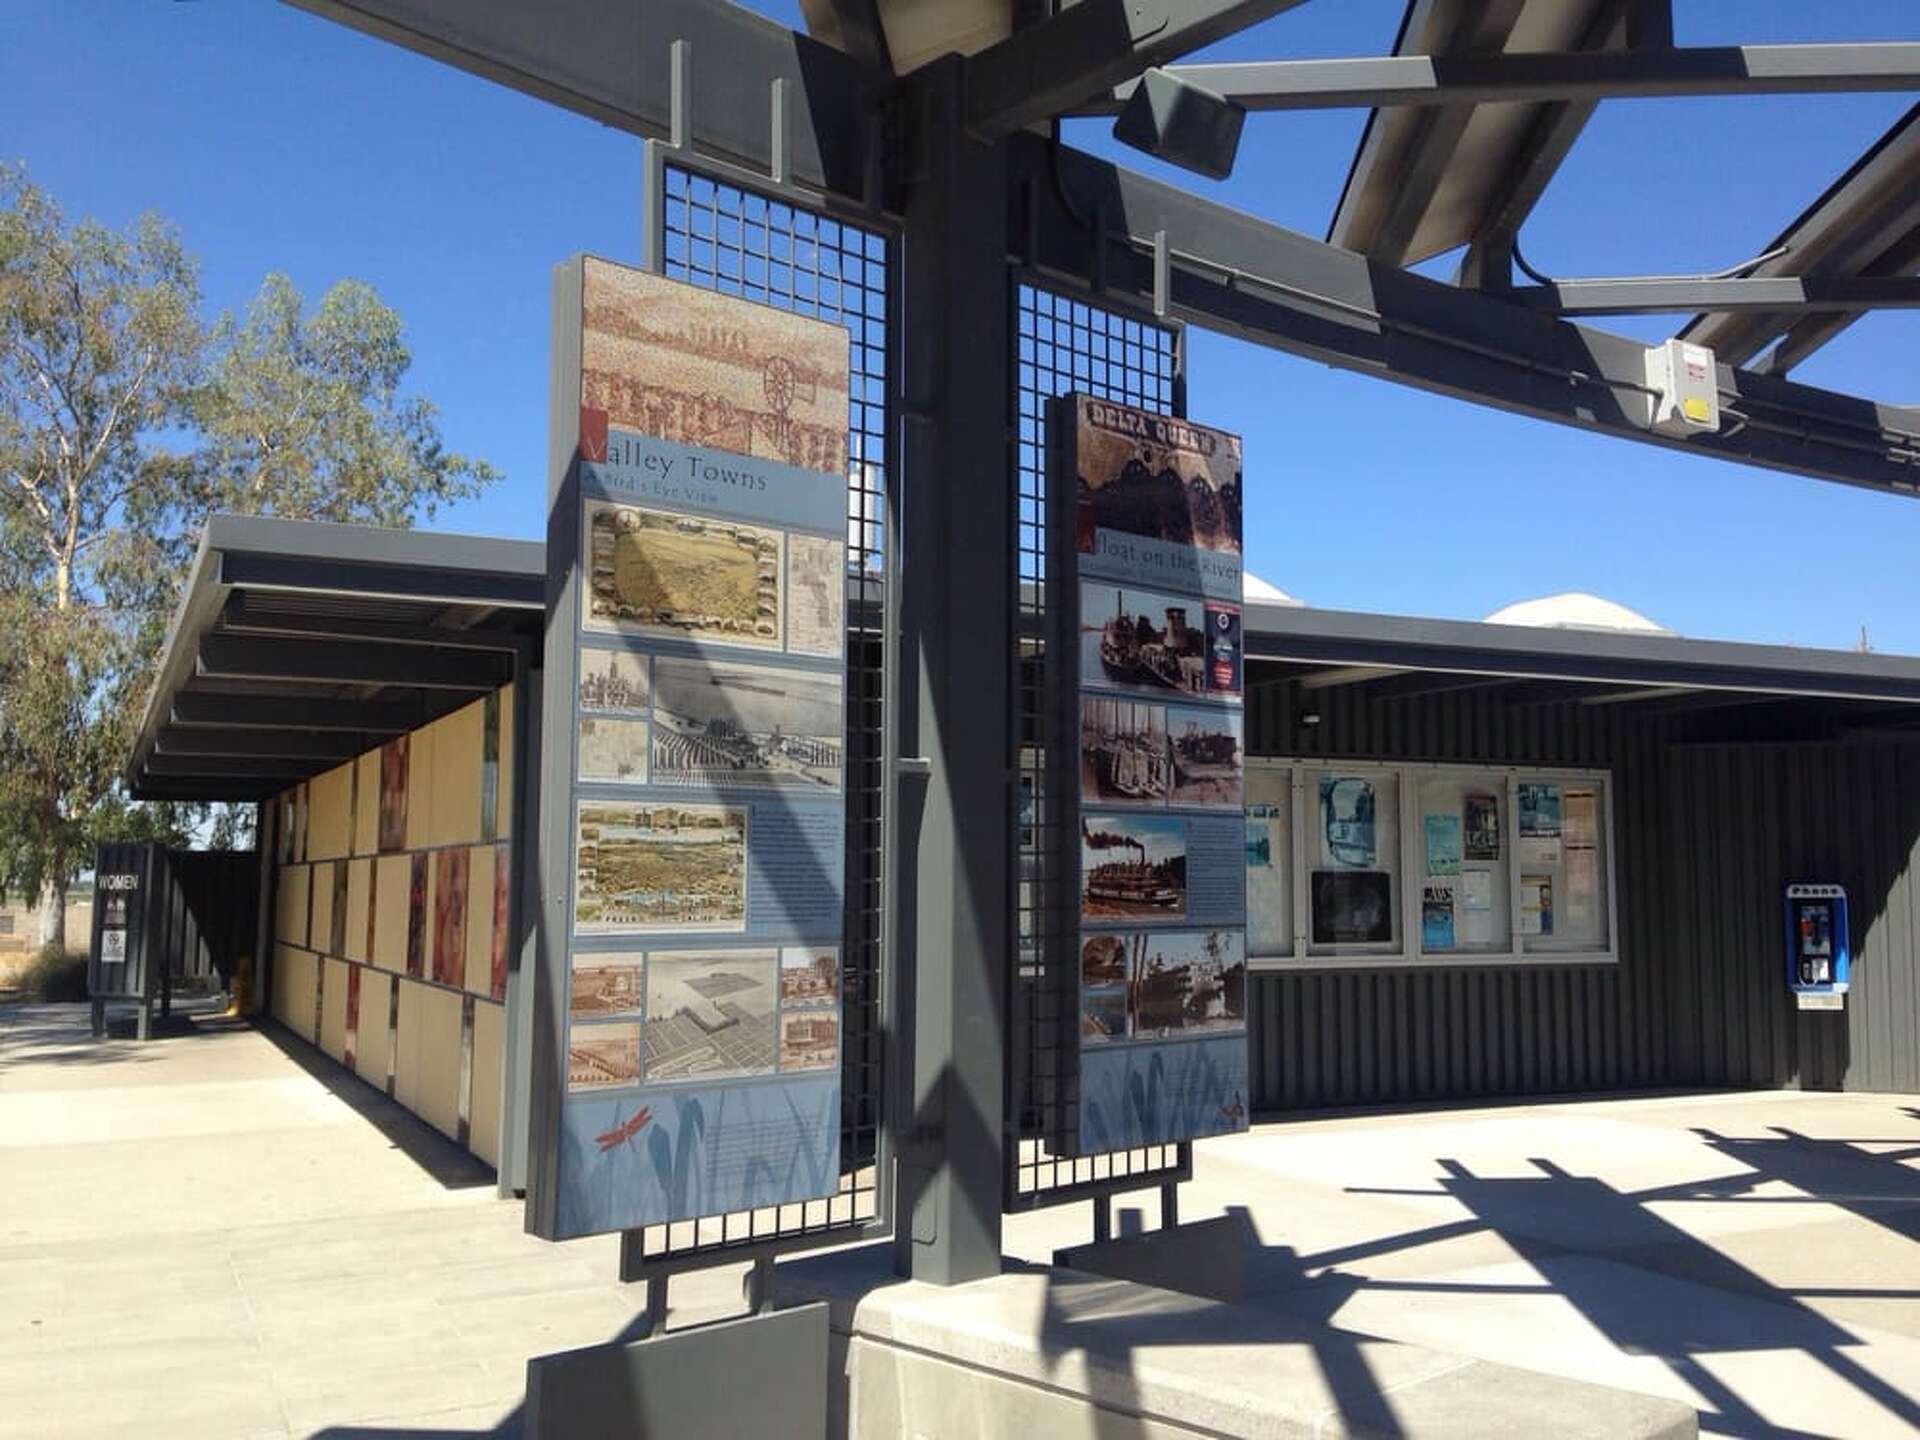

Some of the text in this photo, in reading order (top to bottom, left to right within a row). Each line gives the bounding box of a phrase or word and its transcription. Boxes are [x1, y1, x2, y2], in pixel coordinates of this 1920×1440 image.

[1091, 403, 1215, 454] DELTA QUEEN
[587, 437, 768, 491] Valley Towns
[1141, 550, 1165, 569] on
[1170, 549, 1199, 573] the
[97, 874, 139, 891] WOMEN
